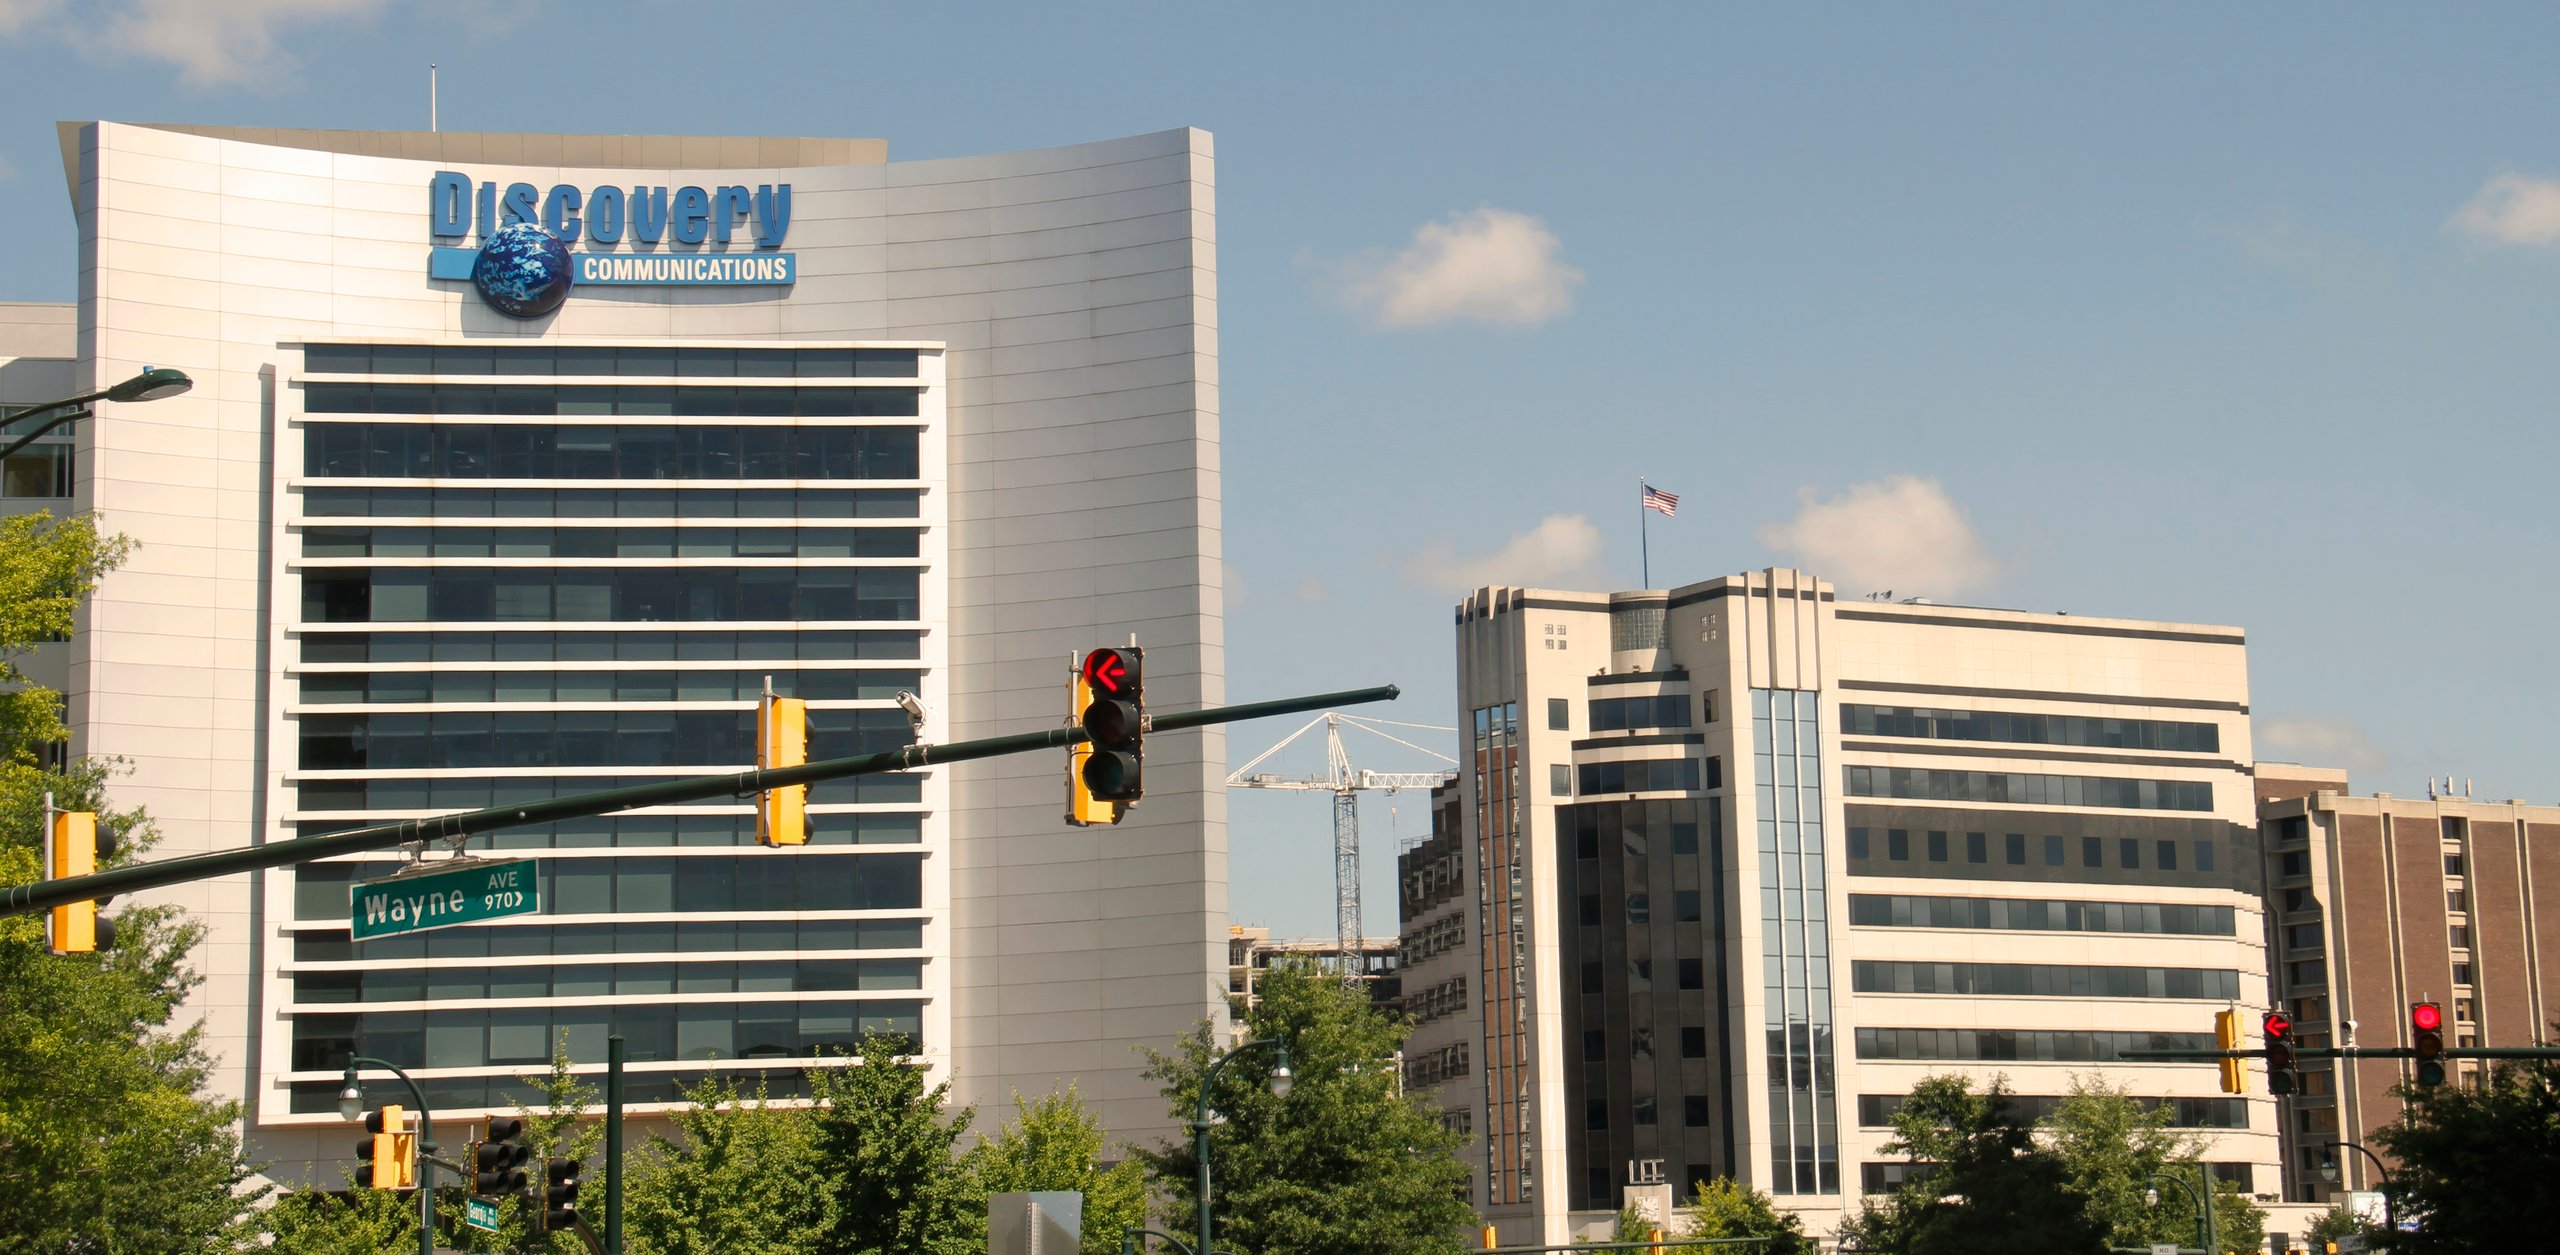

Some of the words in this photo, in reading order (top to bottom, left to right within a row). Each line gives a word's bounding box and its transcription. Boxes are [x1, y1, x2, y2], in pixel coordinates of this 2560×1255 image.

[584, 257, 787, 281] COMMUNICATIONS
[487, 871, 518, 890] AVE
[365, 890, 465, 926] Wayne
[484, 892, 513, 911] 970
[1628, 1158, 1665, 1185] LEE
[470, 1202, 487, 1225] Georgia
